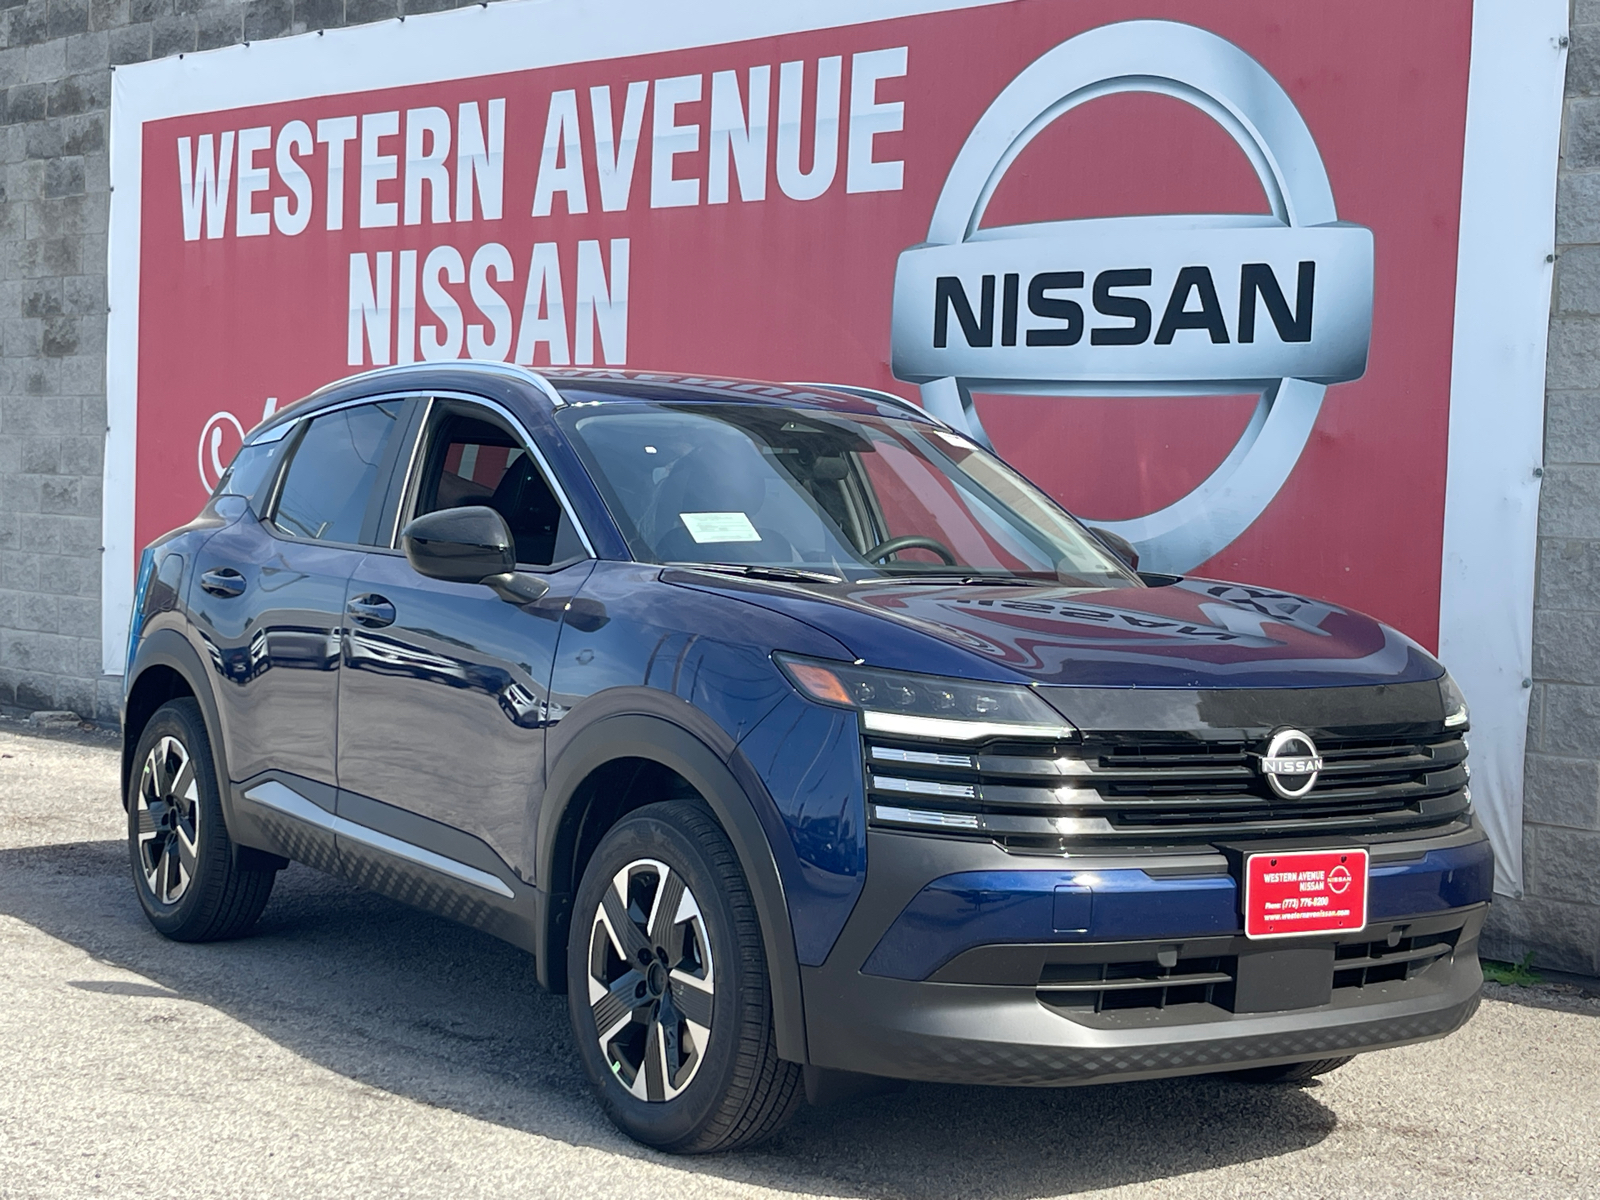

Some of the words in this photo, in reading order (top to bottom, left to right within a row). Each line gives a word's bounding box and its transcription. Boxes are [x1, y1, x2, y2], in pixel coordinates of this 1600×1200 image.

[177, 98, 507, 242] WESTERN
[532, 46, 910, 217] AVENUE
[347, 237, 631, 367] NISSAN
[932, 260, 1316, 349] NISSAN
[1264, 759, 1323, 772] NISSAN
[1263, 872, 1297, 883] WESTERN
[1298, 870, 1325, 881] AVENUE
[1299, 881, 1324, 891] NISSAN
